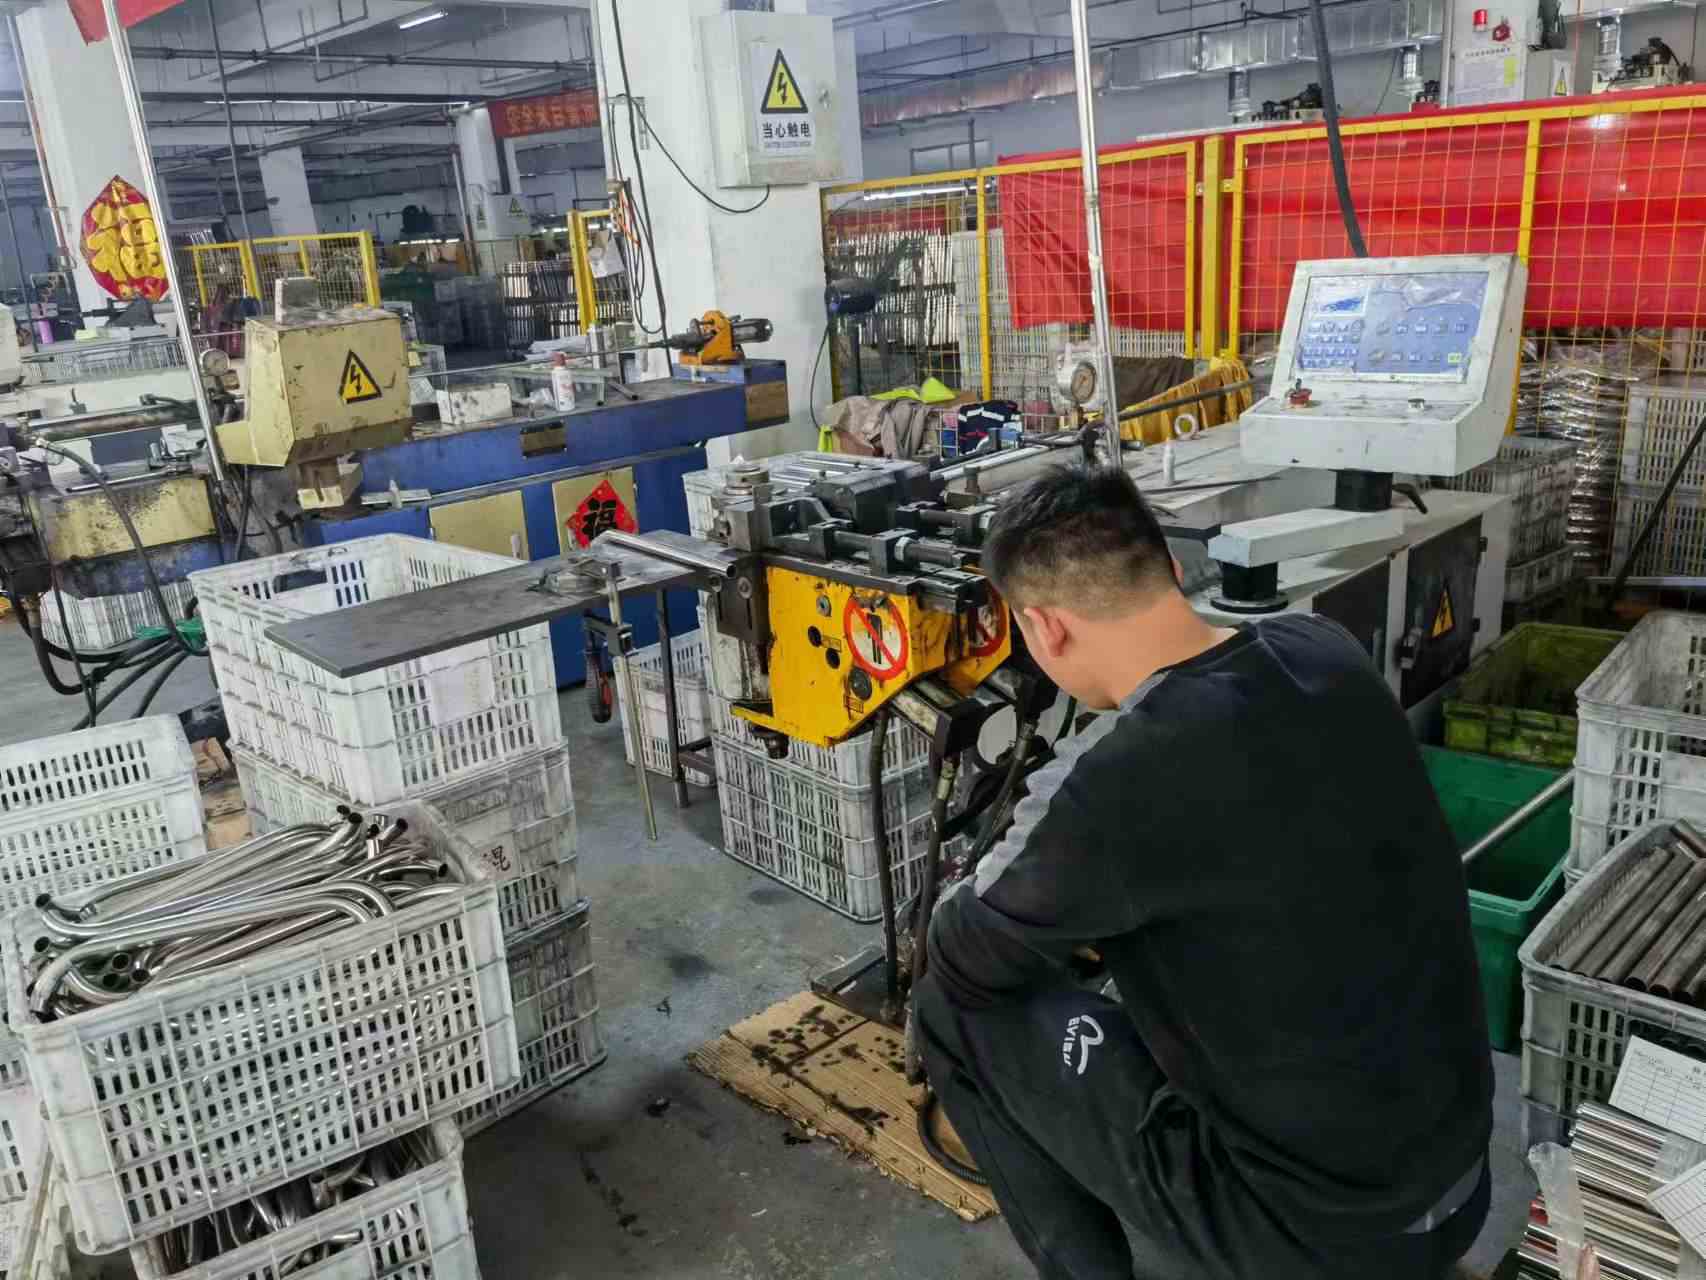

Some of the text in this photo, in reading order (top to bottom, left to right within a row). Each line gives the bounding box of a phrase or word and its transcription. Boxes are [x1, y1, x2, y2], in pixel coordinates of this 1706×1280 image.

[762, 121, 811, 138] 当心触电
[86, 202, 165, 281] 福
